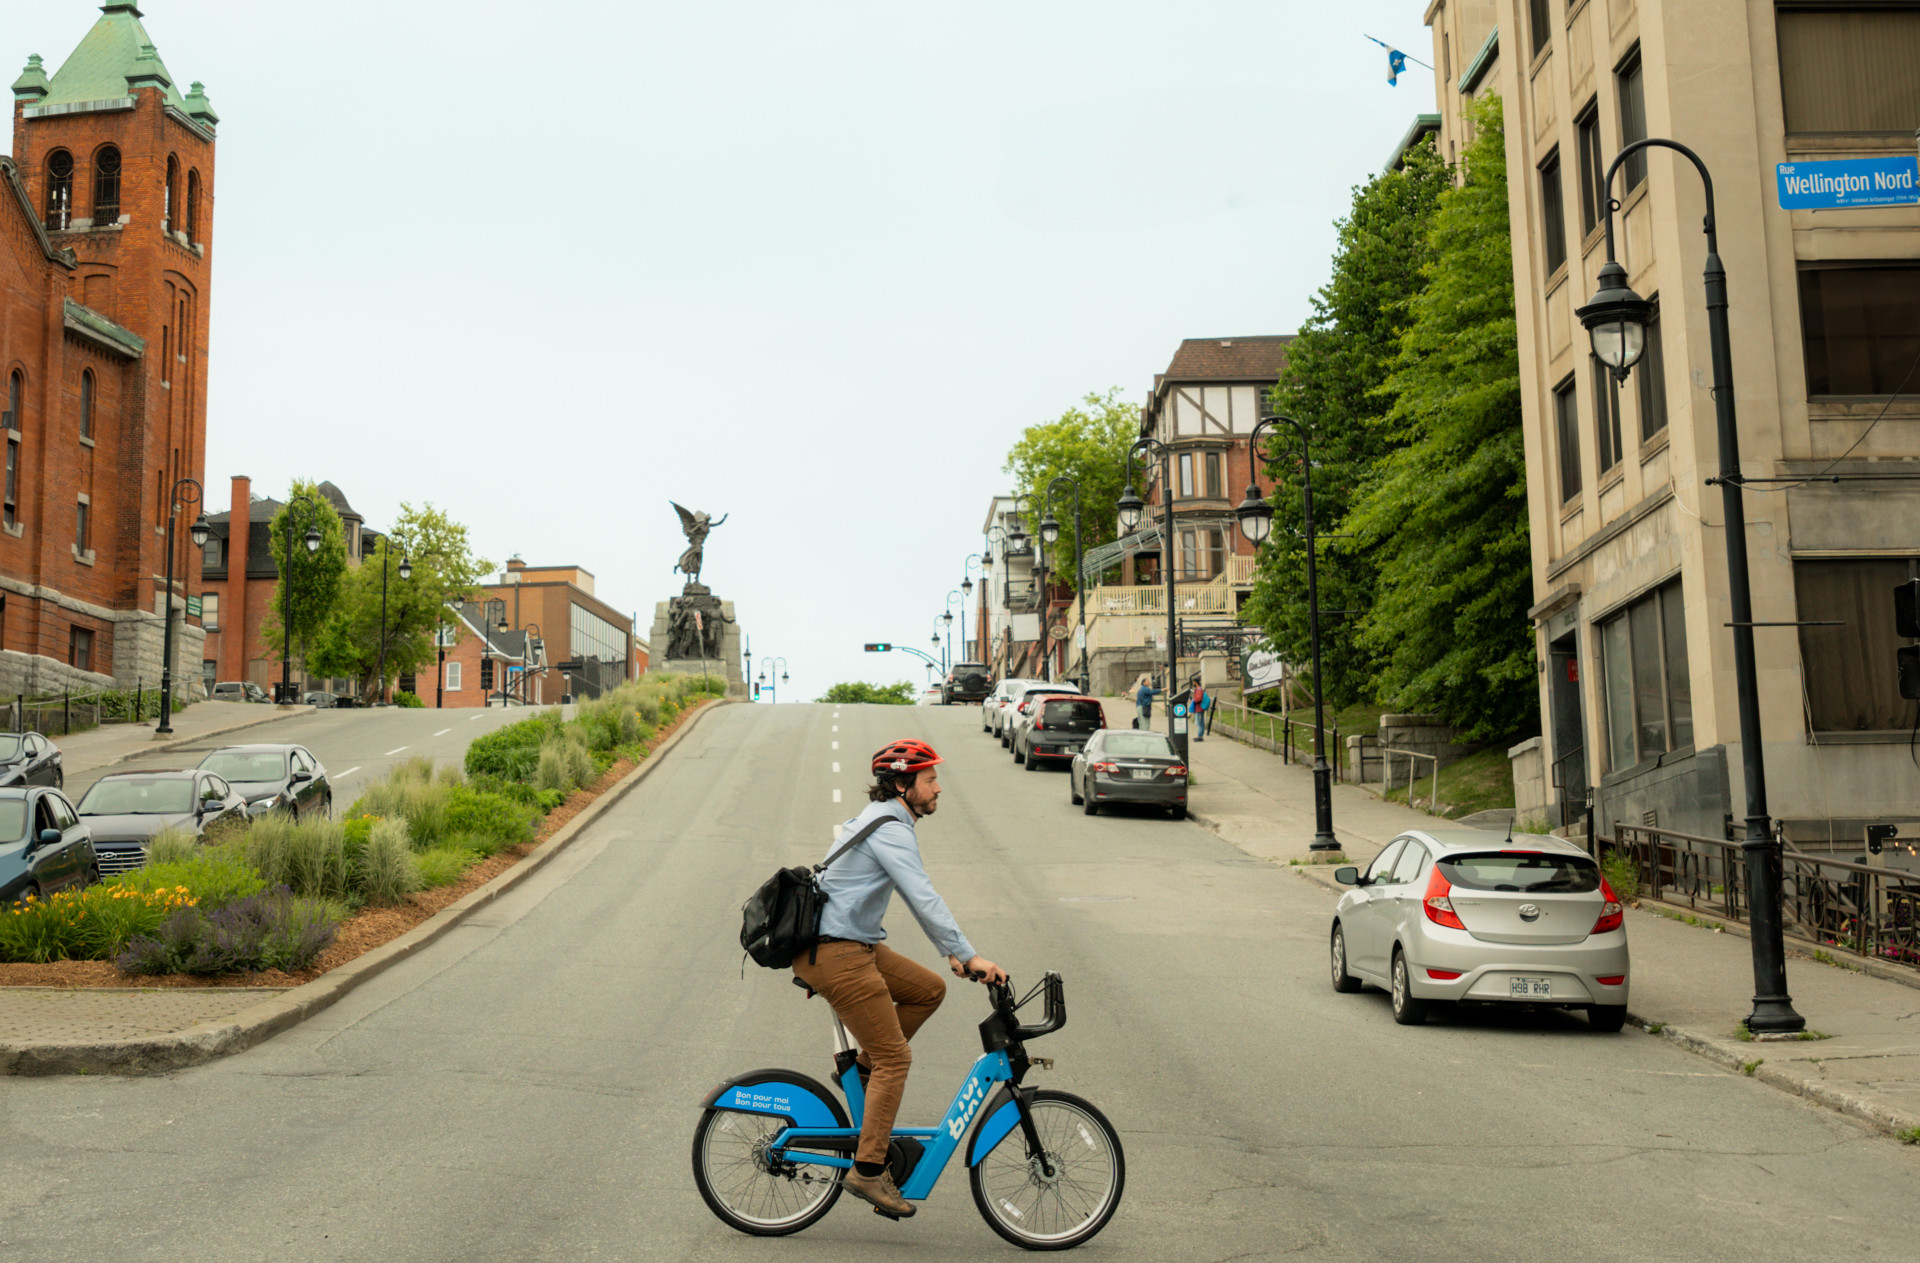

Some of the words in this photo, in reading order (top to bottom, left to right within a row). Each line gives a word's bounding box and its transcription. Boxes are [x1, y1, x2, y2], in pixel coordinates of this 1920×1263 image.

[1779, 165, 1795, 174] Rue
[1785, 173, 1869, 197] Wellington
[1874, 169, 1912, 190] Nord
[1512, 982, 1528, 994] H98
[1533, 984, 1549, 994] RHR
[736, 1091, 751, 1099] Bon
[753, 1094, 772, 1102] pour
[735, 1098, 750, 1106] Bon
[752, 1101, 771, 1109] pour
